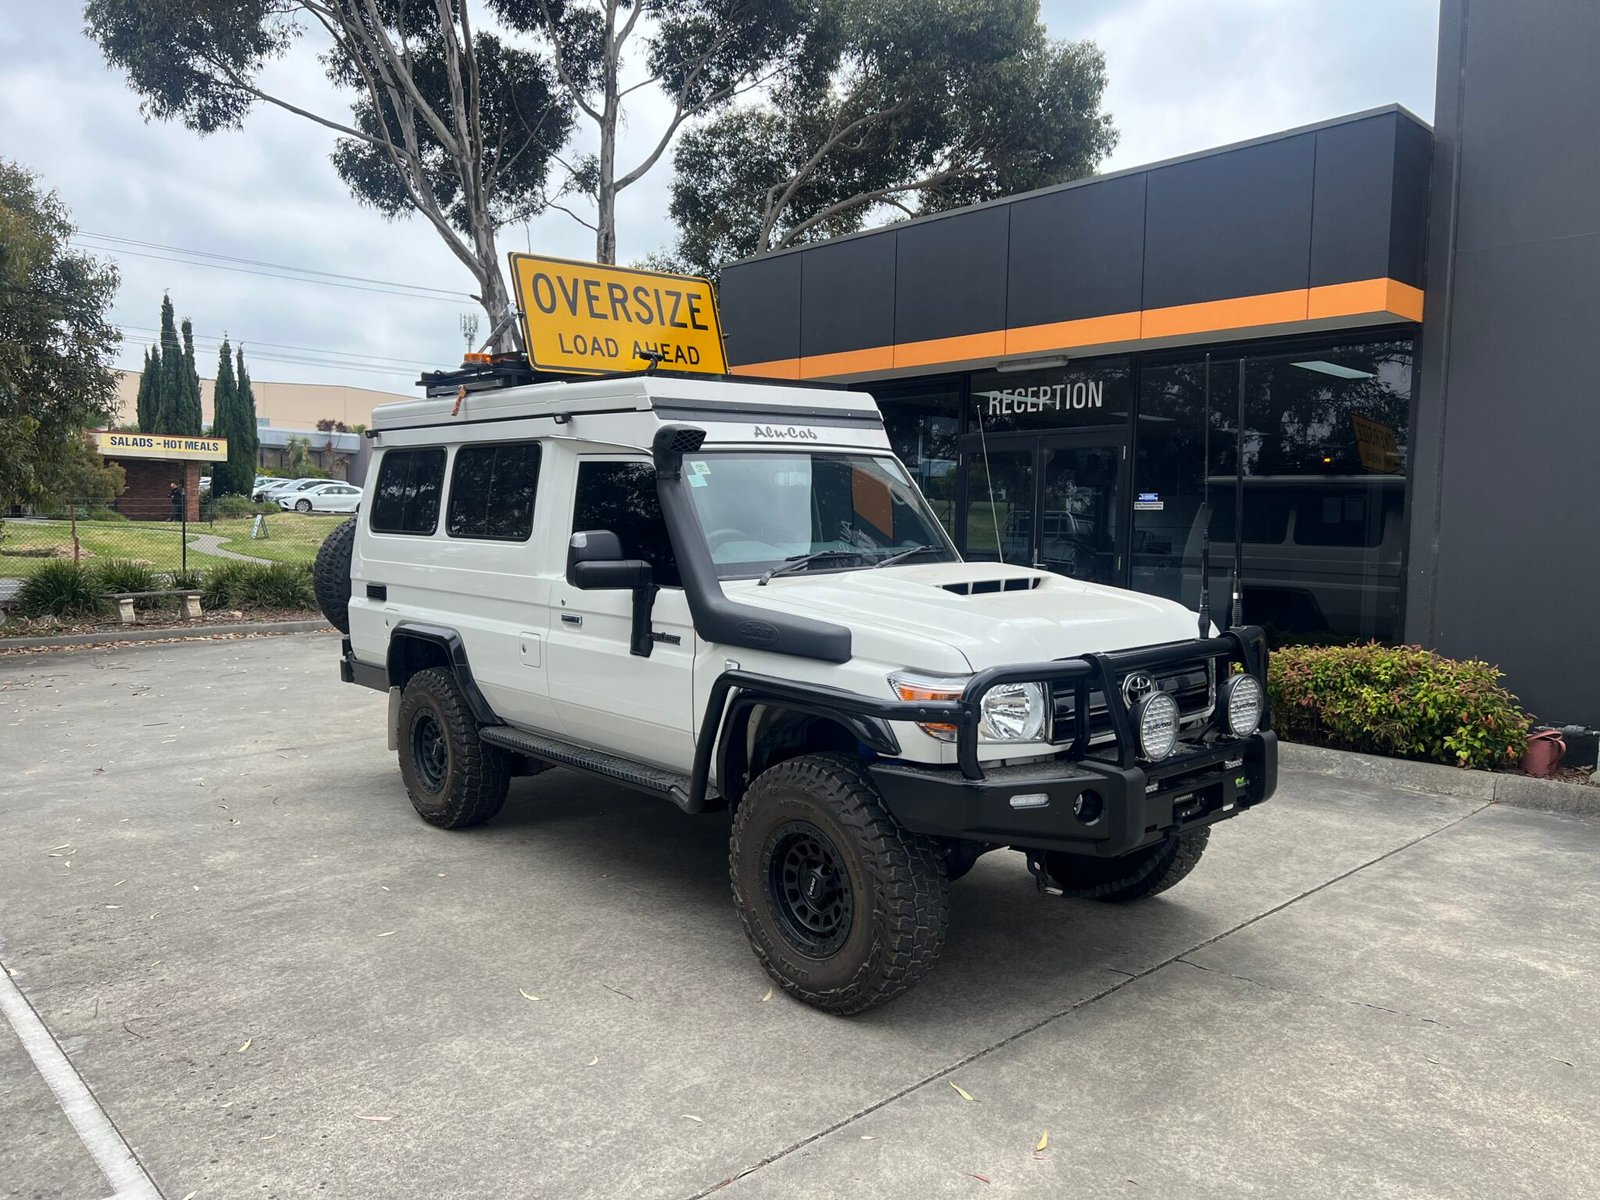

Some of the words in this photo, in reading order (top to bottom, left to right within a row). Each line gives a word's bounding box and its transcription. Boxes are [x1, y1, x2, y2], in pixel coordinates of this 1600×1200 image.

[532, 273, 708, 330] OVERSIZE
[558, 333, 619, 358] LOAD
[632, 340, 700, 365] AHEAD
[988, 380, 1103, 415] RECEPTION
[110, 436, 153, 448] SALADS
[163, 439, 183, 449] HOT
[184, 440, 219, 451] MEALS
[753, 425, 818, 440] Alu-Cab
